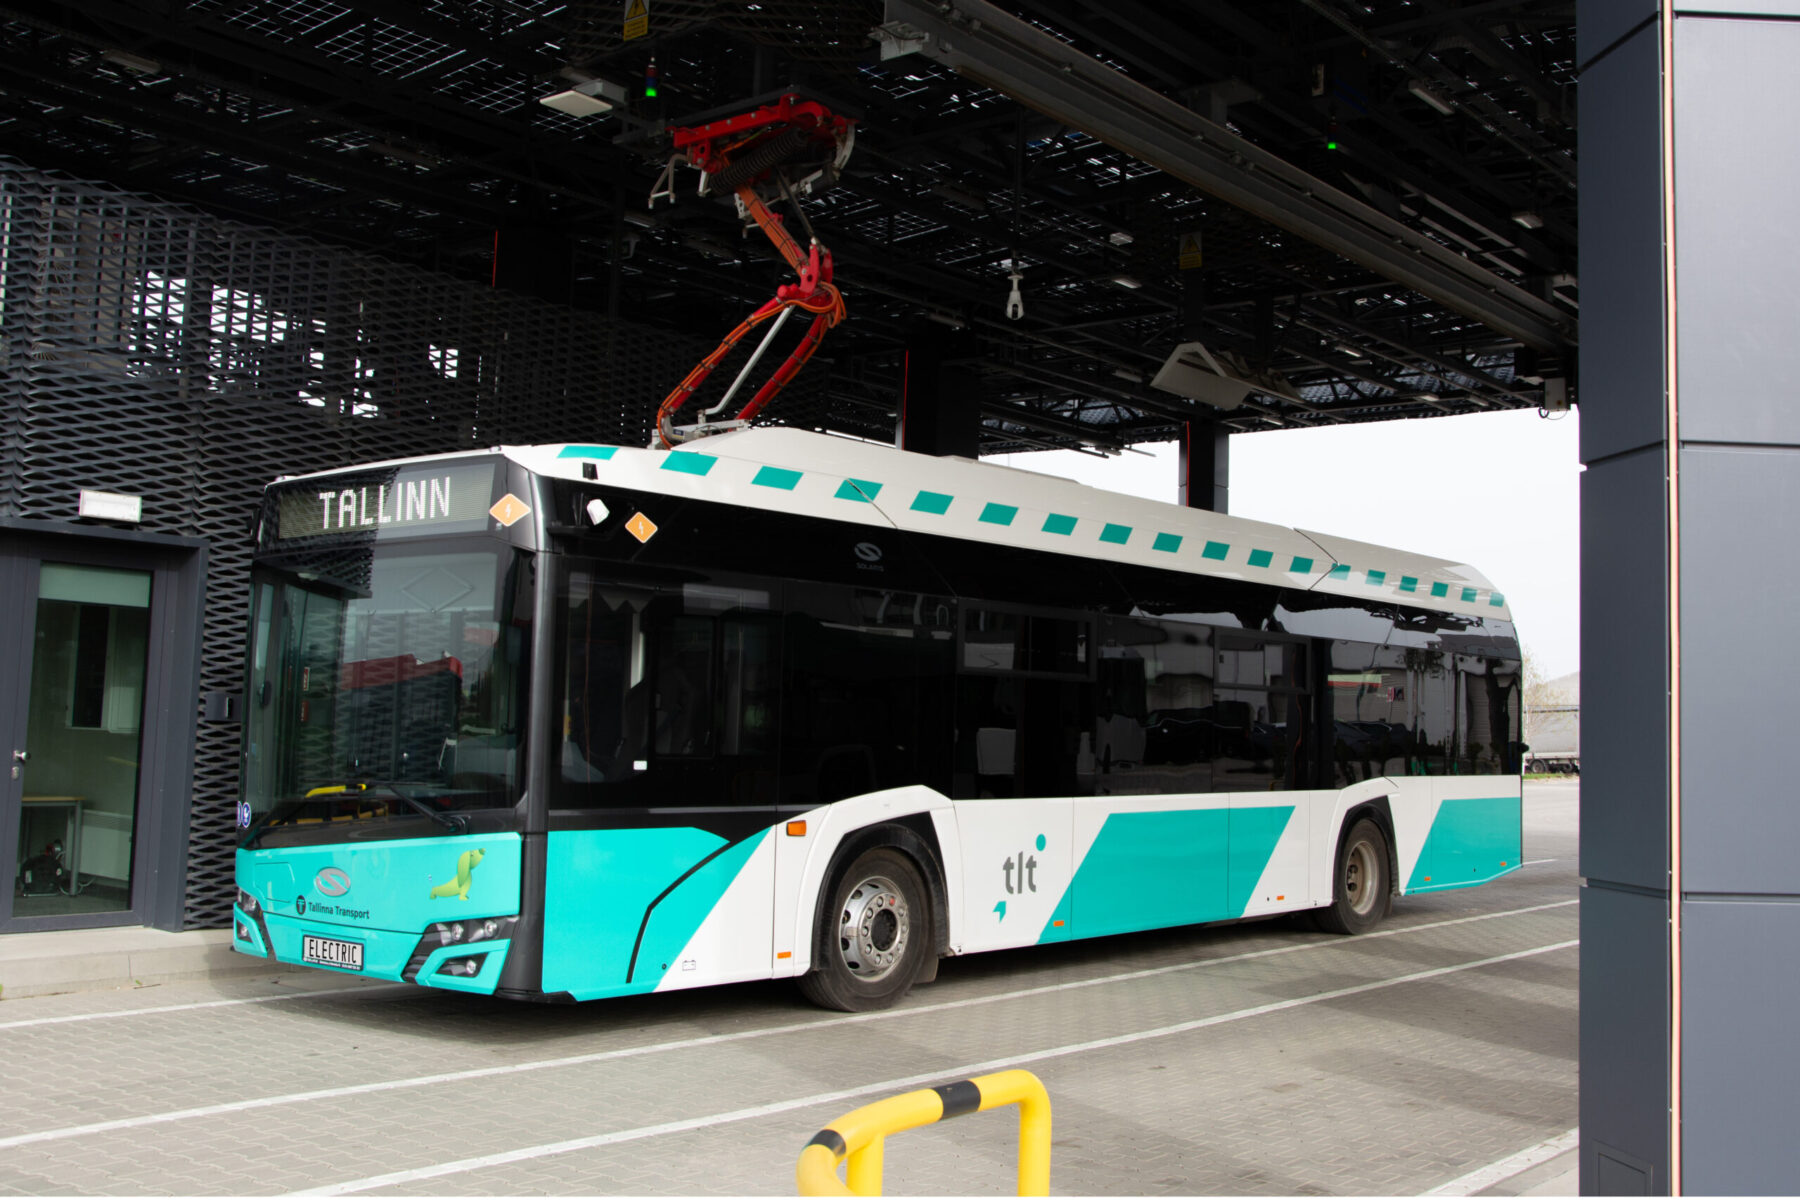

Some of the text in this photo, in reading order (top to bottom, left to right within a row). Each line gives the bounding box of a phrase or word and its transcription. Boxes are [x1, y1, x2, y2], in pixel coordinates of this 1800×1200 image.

[319, 476, 450, 529] TALLINN
[1003, 851, 1037, 894] tlt
[309, 902, 370, 919] Tallinna Transport
[309, 939, 357, 964] ELECTRIC
